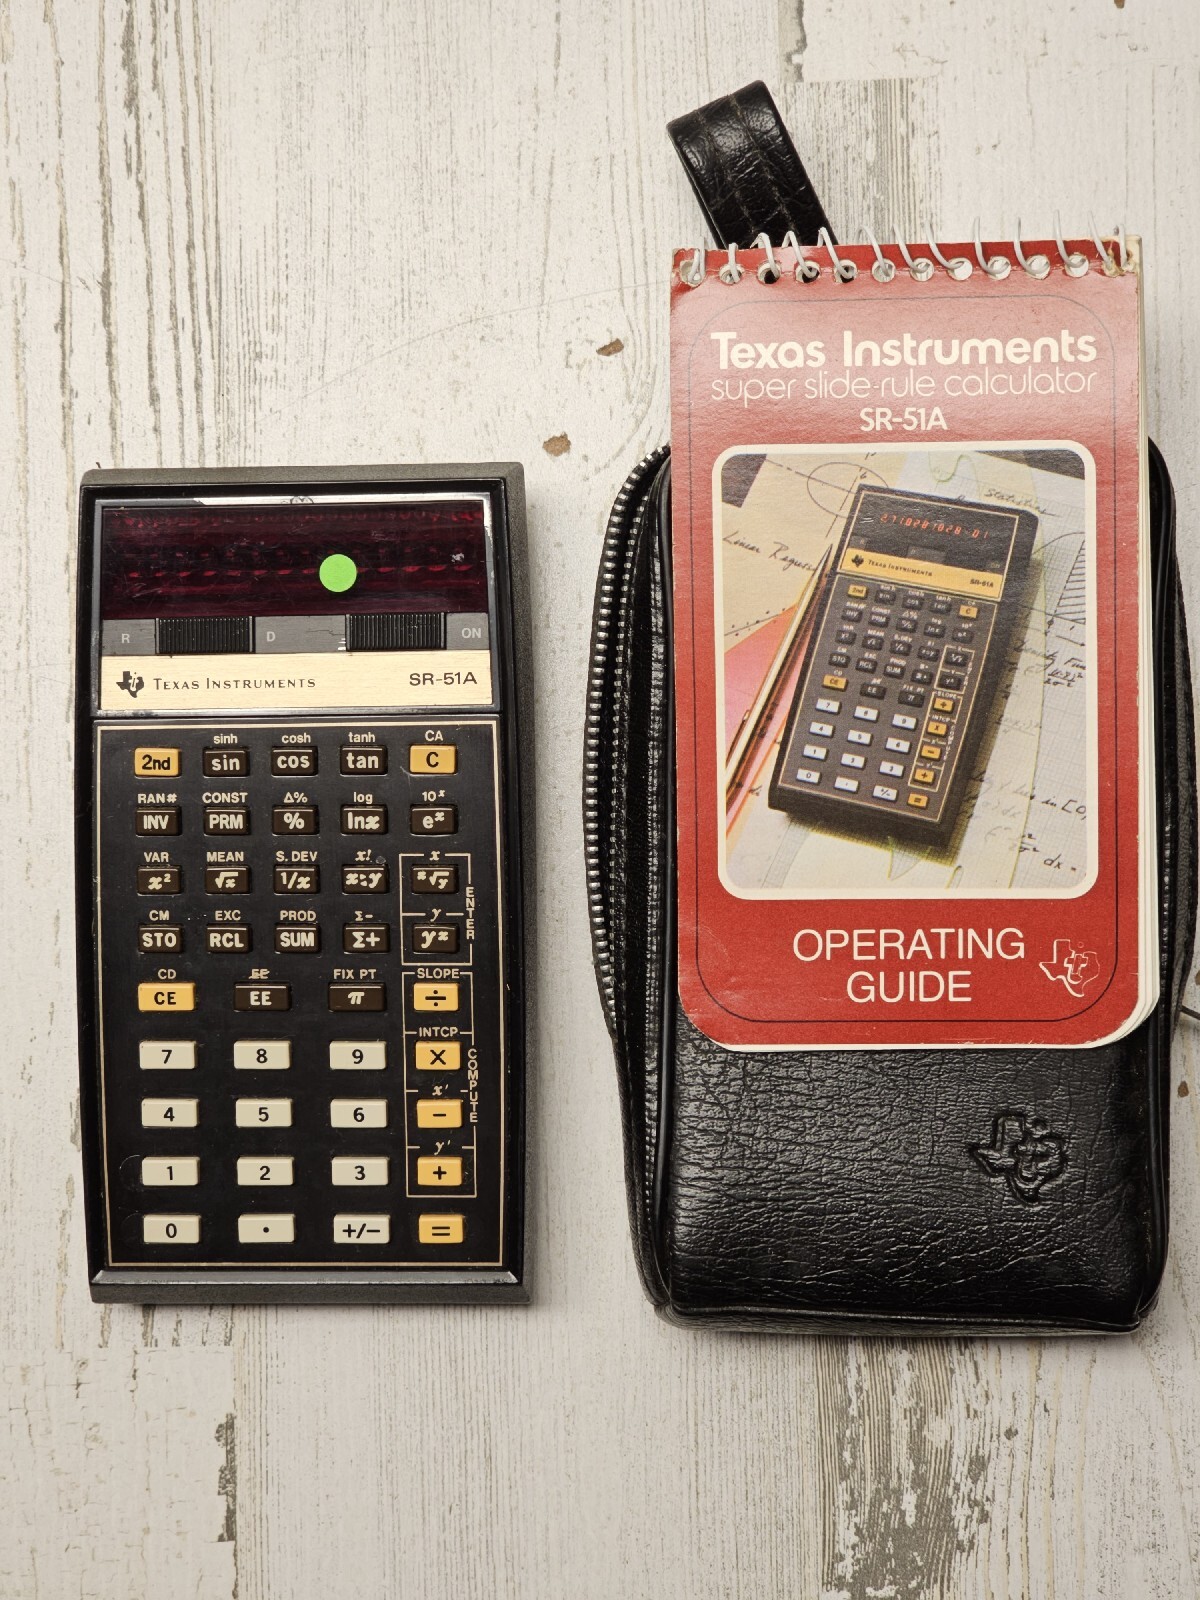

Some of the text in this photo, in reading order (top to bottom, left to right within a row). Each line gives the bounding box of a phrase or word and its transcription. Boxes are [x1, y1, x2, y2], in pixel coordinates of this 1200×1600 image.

[711, 329, 1097, 370] Texas Instruments
[711, 366, 1097, 408] super slide-rule calculator
[859, 407, 948, 431] SR-51A
[121, 634, 130, 644] R
[266, 631, 275, 642] D
[461, 628, 481, 639] ON
[409, 672, 478, 686] SR-51A
[213, 733, 238, 744] sinh
[281, 732, 311, 744] cosh
[348, 732, 376, 743] tanh
[424, 730, 444, 741] CA
[142, 754, 170, 770] 2nd
[212, 754, 240, 771] sin
[277, 755, 310, 768] cos
[346, 752, 379, 768] tan
[426, 751, 439, 768] C
[202, 792, 248, 803] CONST
[353, 792, 373, 804] log
[143, 815, 169, 829] INV
[209, 814, 243, 829] PRM
[284, 813, 305, 829] %
[143, 852, 169, 862] VAR
[206, 851, 244, 862] MEAN
[149, 910, 170, 921] CM
[215, 910, 241, 921] EXC
[280, 910, 316, 921] PROD
[142, 933, 177, 948] STO
[209, 933, 244, 948] RCL
[280, 932, 315, 947] SUM
[793, 928, 1025, 961] OPERATING
[158, 969, 176, 979] CD
[333, 969, 377, 979] FIX PT
[417, 968, 460, 979] SLOPE
[847, 970, 972, 1003] GUIDE
[154, 992, 177, 1005] CE
[250, 991, 272, 1006] EE
[419, 1027, 458, 1037] INTCP
[161, 1049, 173, 1064] 7
[256, 1048, 268, 1063] 8
[352, 1049, 364, 1064] 9
[163, 1107, 175, 1122] 4
[258, 1107, 269, 1122] 5
[353, 1107, 365, 1122] 6
[166, 1166, 173, 1180] 1
[259, 1166, 271, 1180] 2
[354, 1165, 366, 1180] 3
[165, 1223, 177, 1238] 0
